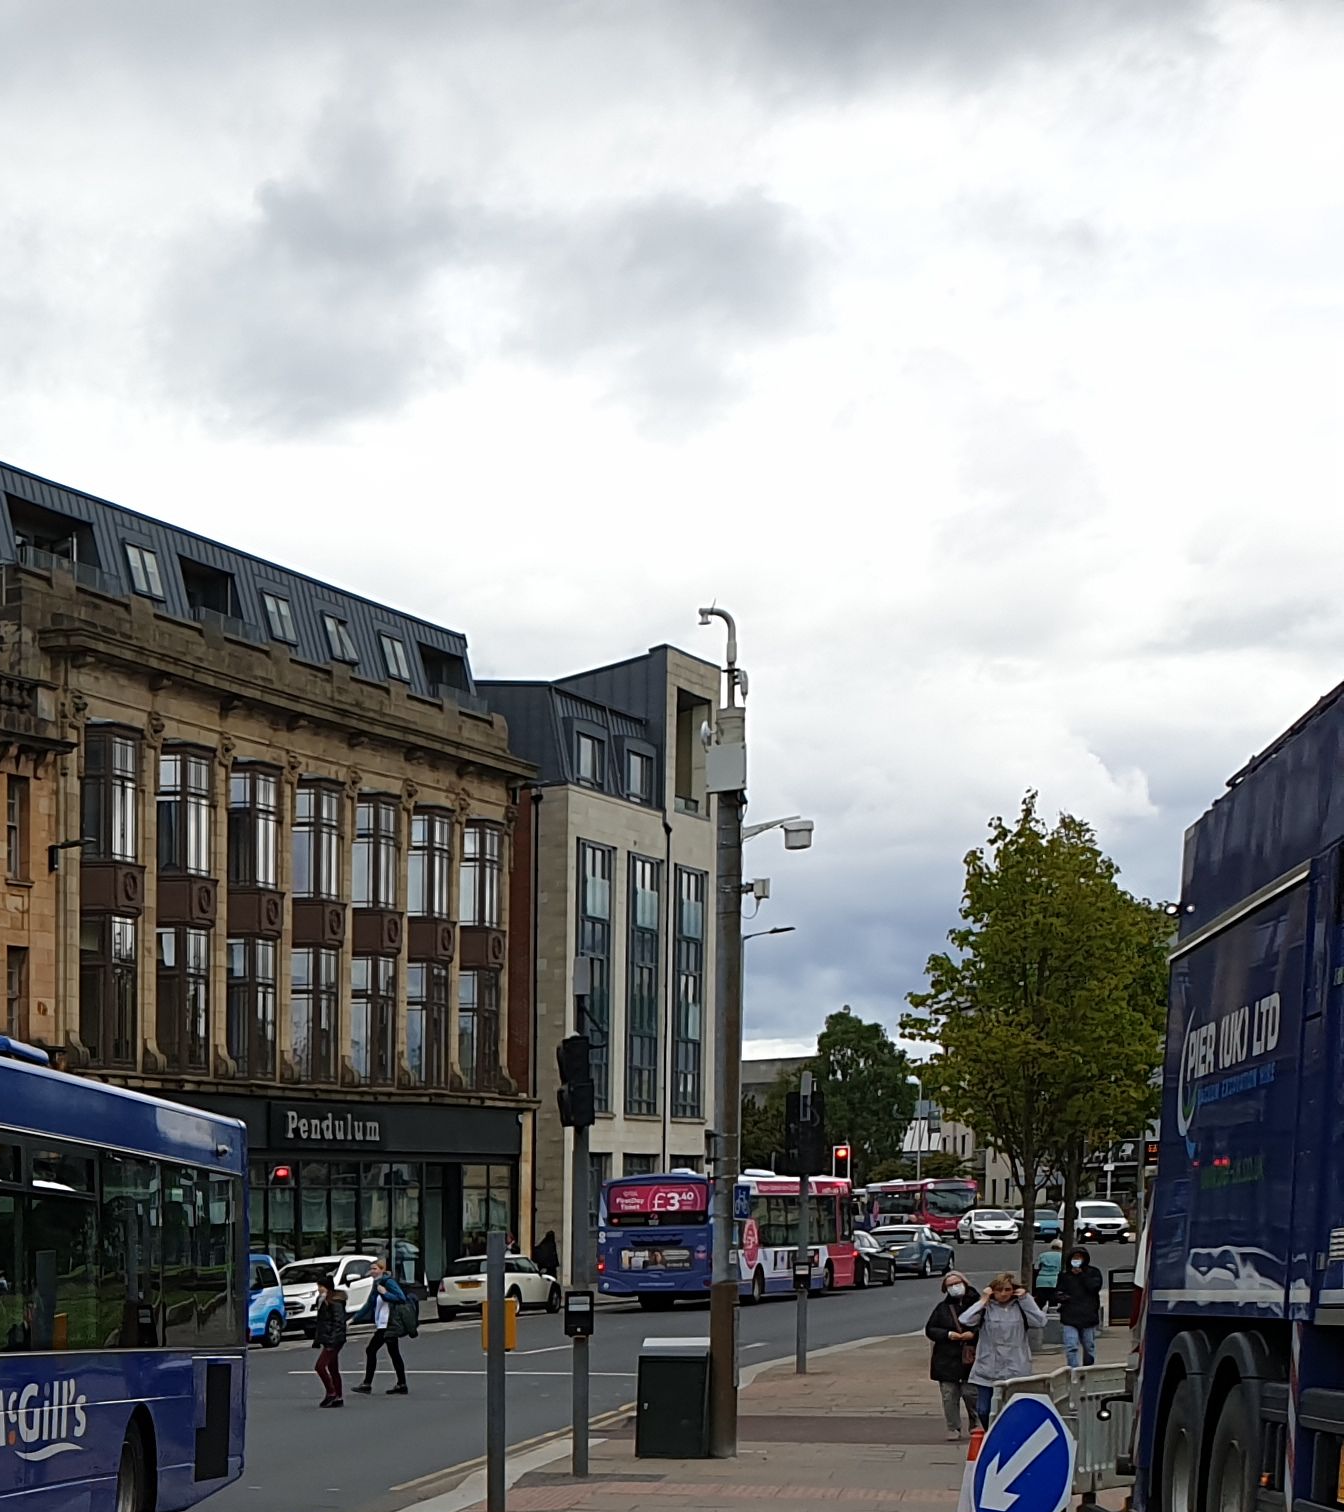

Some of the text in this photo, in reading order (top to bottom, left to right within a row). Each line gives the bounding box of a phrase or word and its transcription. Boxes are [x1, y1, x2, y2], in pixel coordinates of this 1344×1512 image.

[1187, 992, 1281, 1082] PIER (UK) LTD
[285, 1111, 380, 1141] Pendulum
